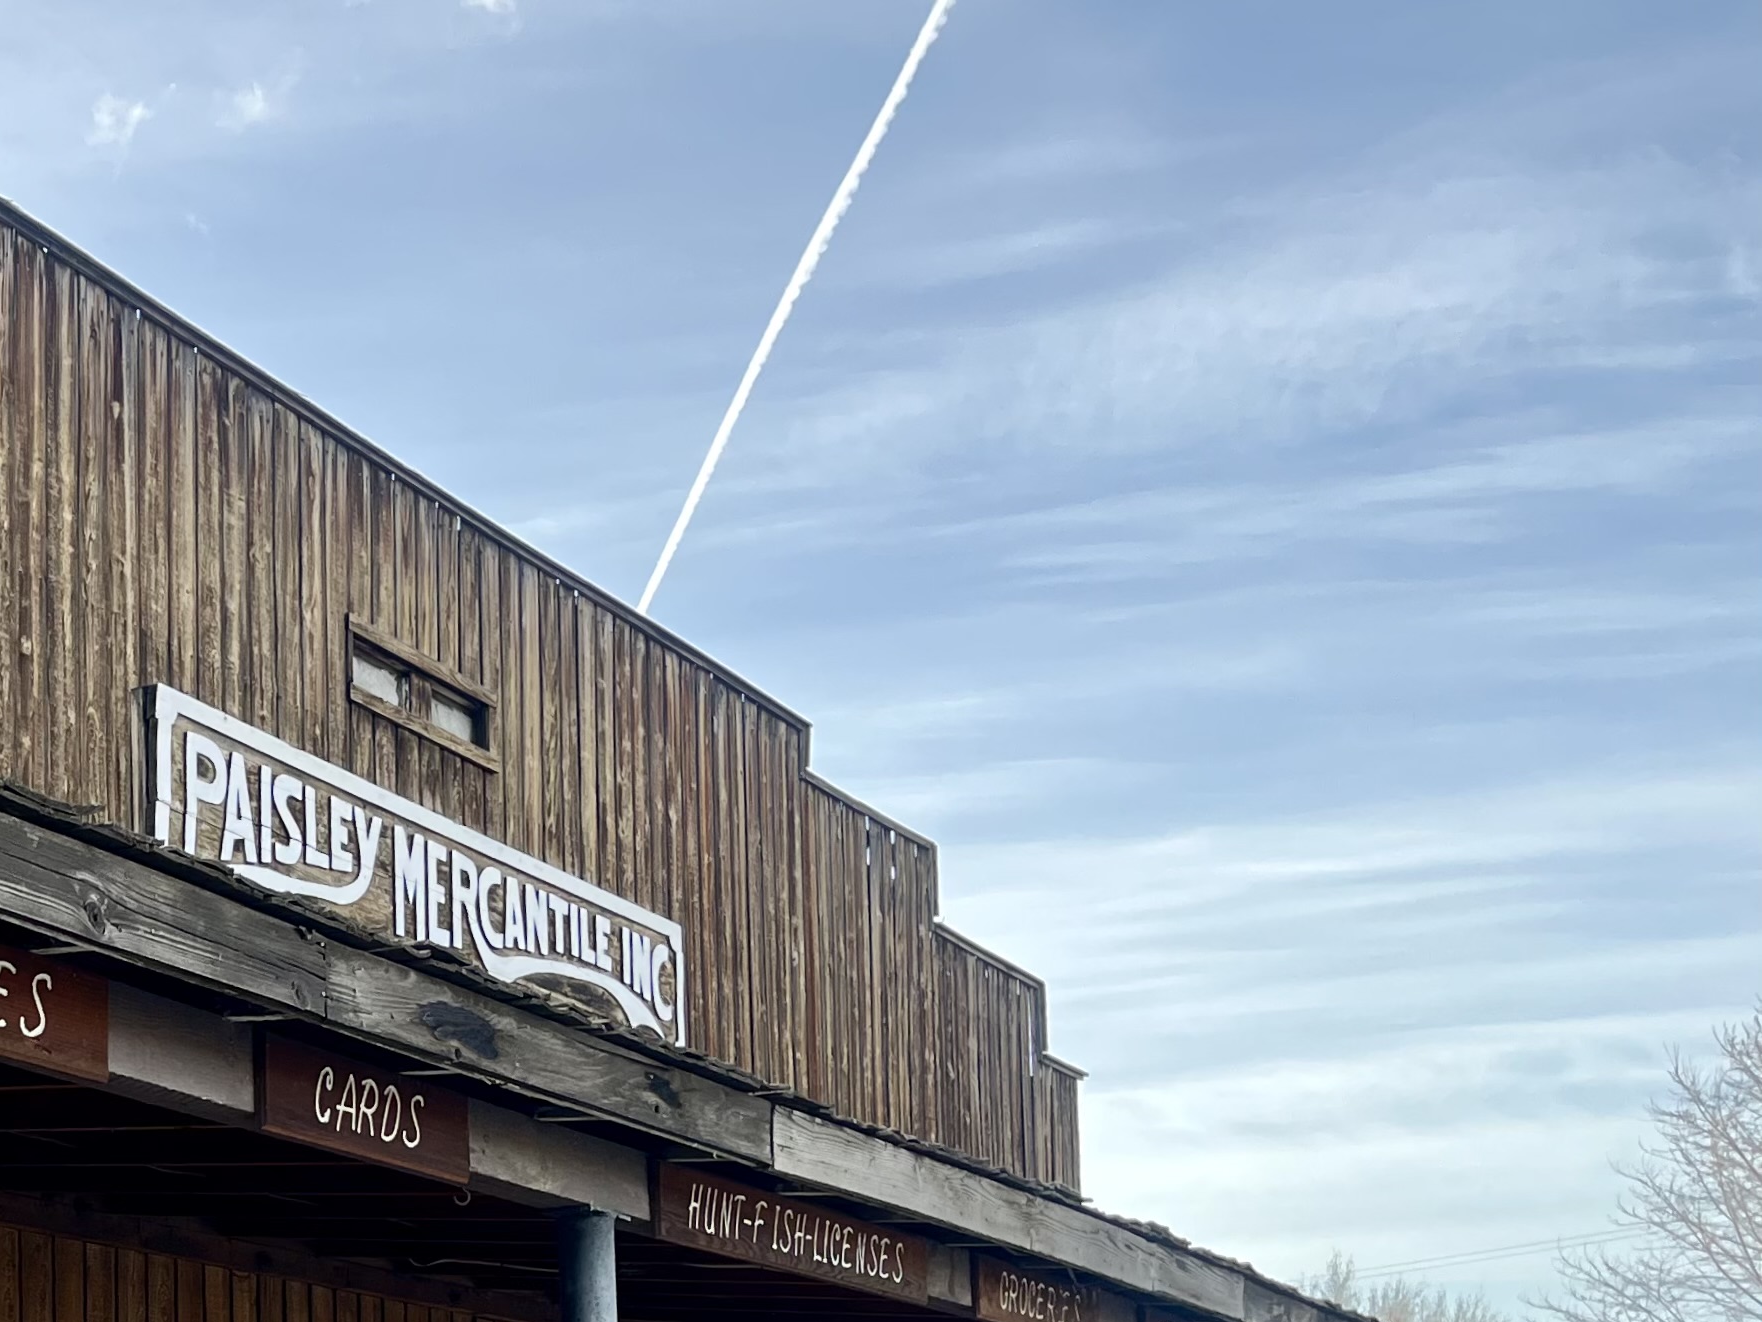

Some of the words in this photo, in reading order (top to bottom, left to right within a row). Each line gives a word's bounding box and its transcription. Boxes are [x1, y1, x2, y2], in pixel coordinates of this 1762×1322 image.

[185, 730, 383, 905] PAISLEY
[393, 824, 612, 984] MERCANTILE
[621, 926, 673, 1022] INC
[314, 1066, 425, 1149] CARDS
